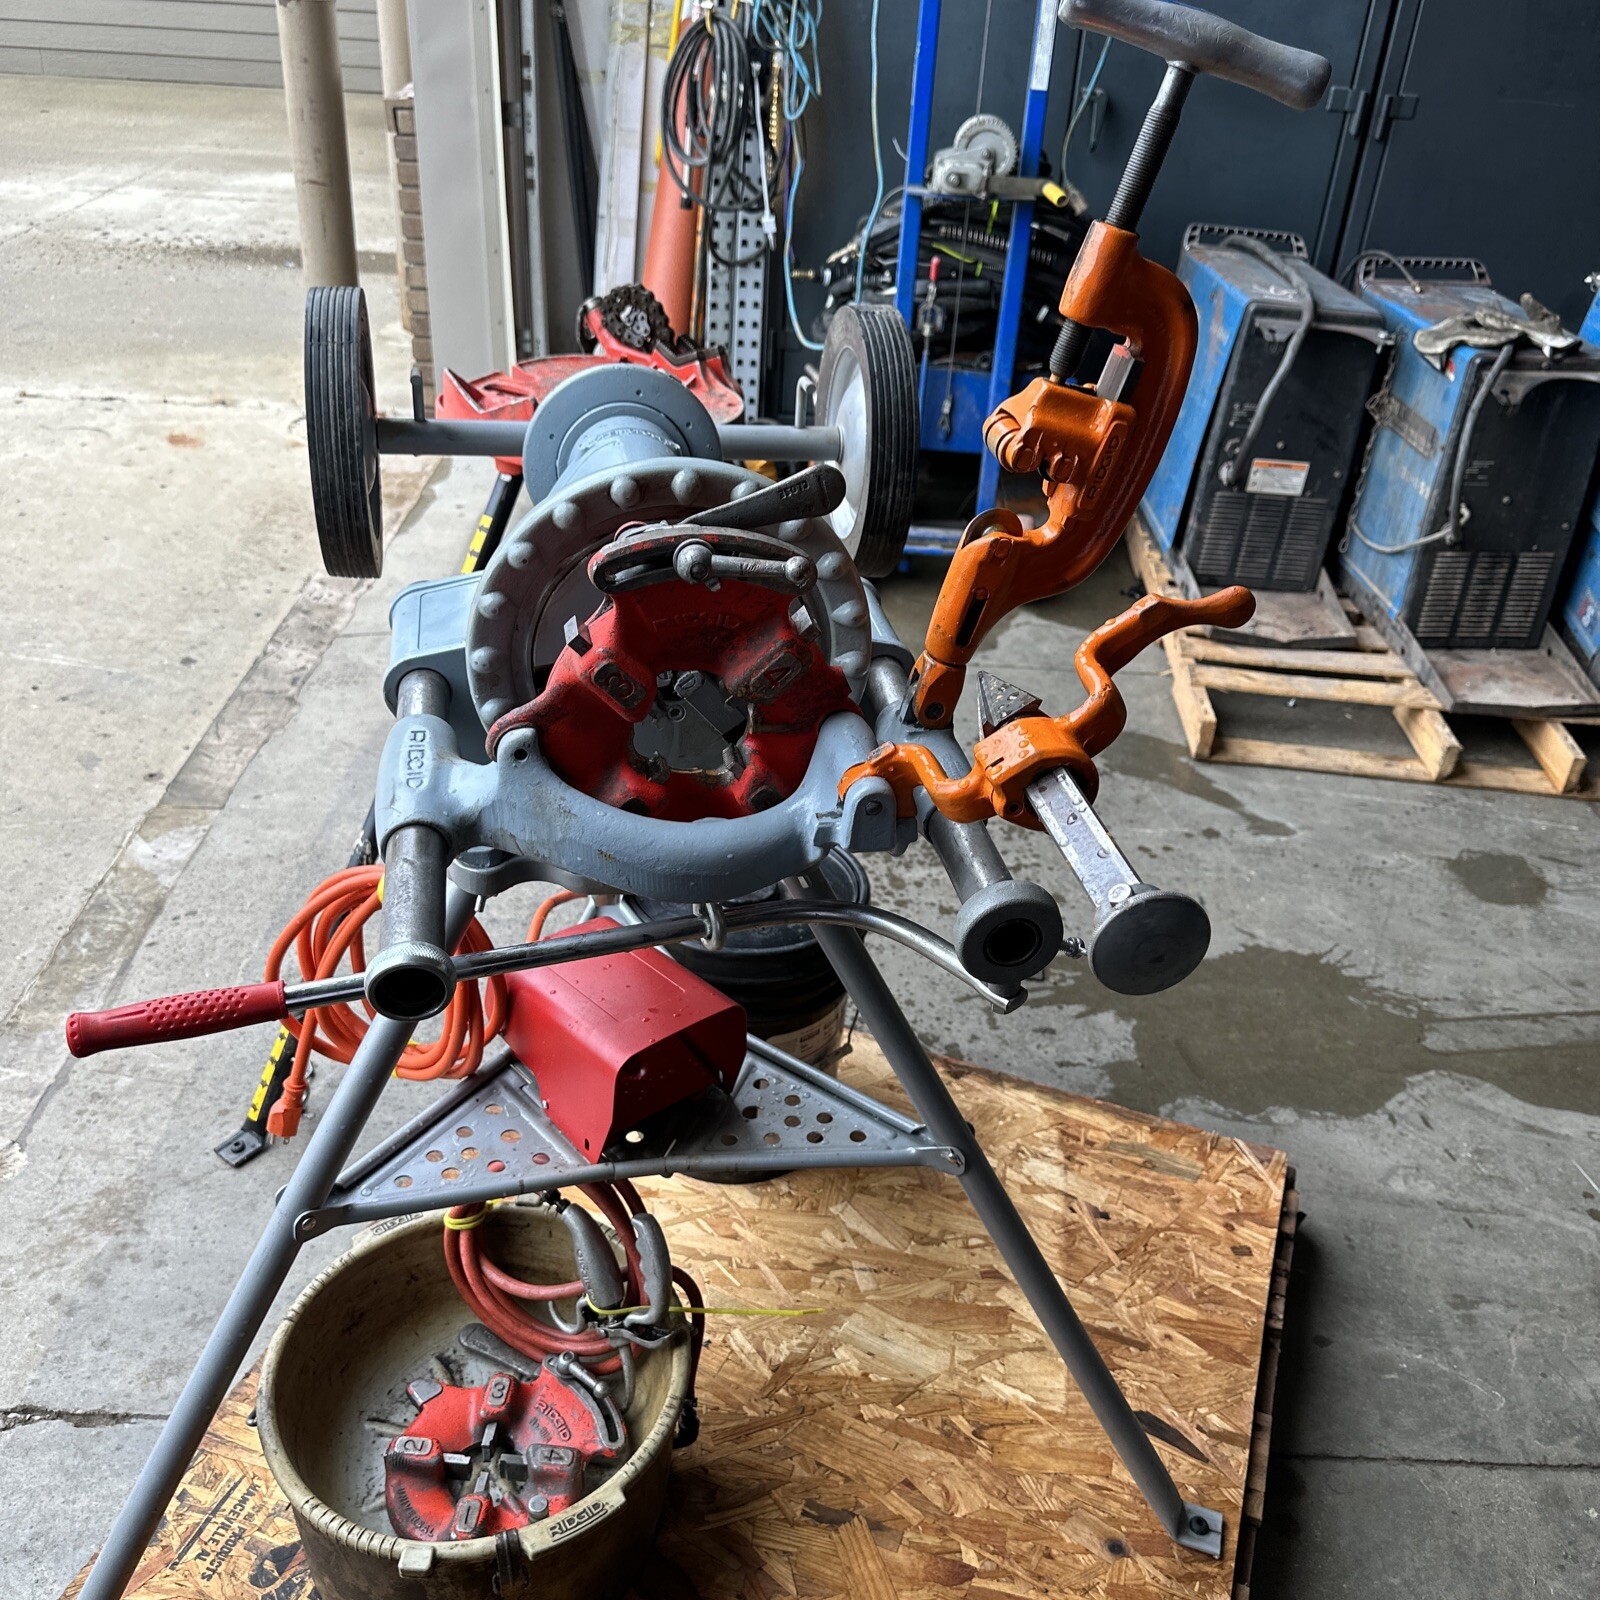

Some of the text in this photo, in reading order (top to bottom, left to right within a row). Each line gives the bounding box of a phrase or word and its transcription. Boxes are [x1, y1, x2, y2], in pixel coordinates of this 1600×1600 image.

[1089, 435, 1120, 499] RIDGID
[605, 672, 635, 699] 3
[763, 666, 792, 687] 4
[406, 729, 427, 788] RIDGID
[491, 1383, 505, 1398] 3
[535, 1402, 571, 1442] RIDGID
[404, 1439, 424, 1452] 2
[544, 1449, 565, 1462] 4
[399, 1486, 434, 1538] UNIVERSAL
[549, 1500, 605, 1538] RIDGID
[201, 1525, 247, 1582] PRODUCTS
